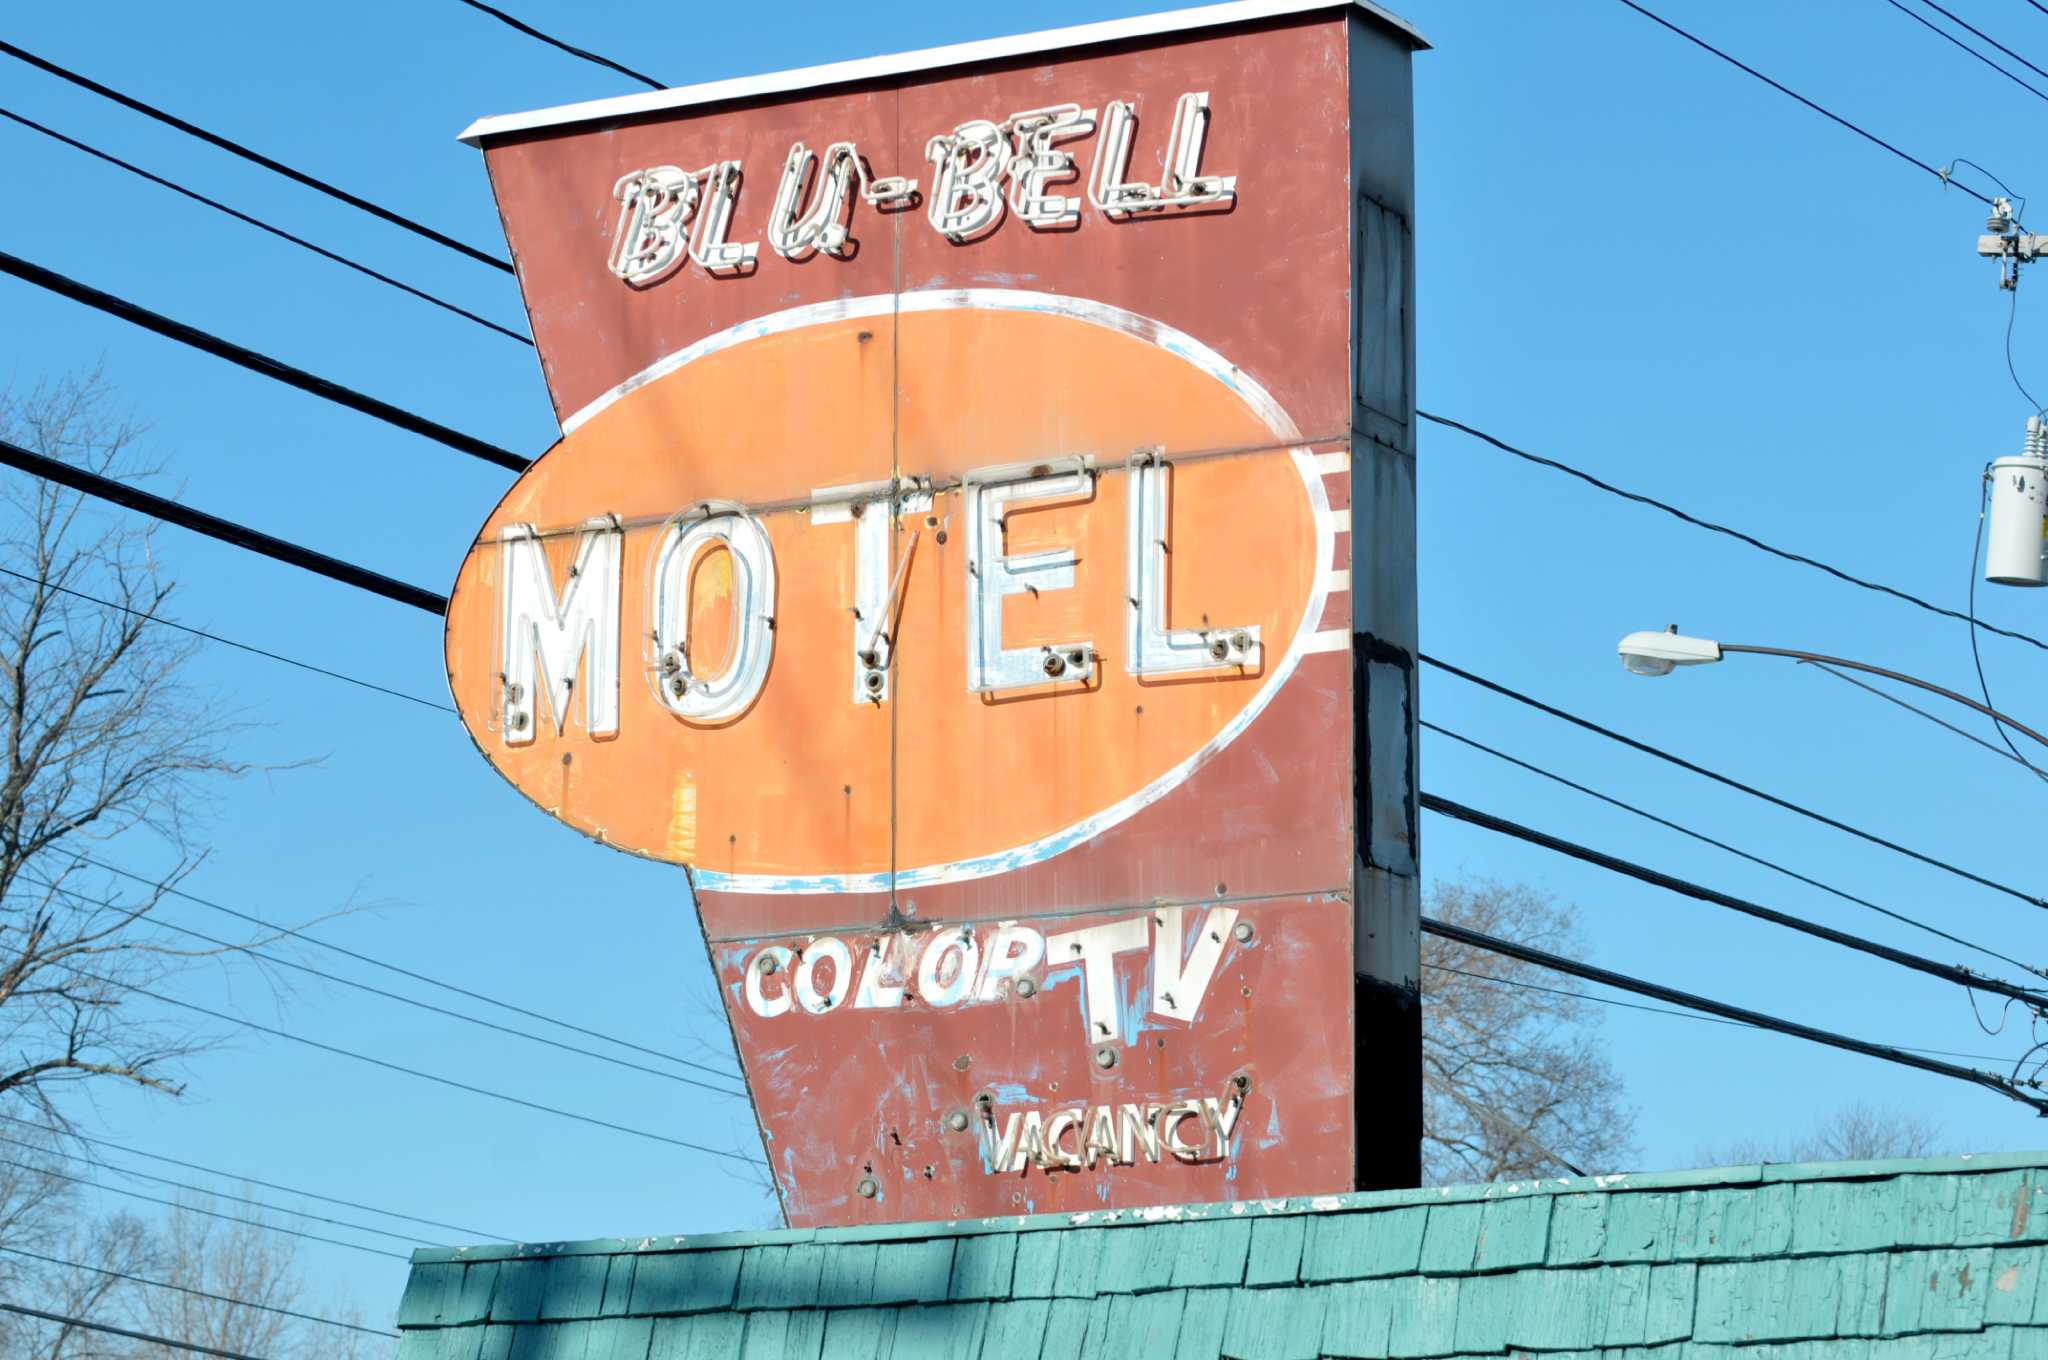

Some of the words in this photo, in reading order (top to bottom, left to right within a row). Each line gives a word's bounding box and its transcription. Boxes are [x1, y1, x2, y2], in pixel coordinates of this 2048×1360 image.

[607, 91, 1238, 288] BLU-BELL
[490, 446, 1264, 746] MOTEL
[1046, 906, 1239, 1044] TV
[980, 1096, 1240, 1172] VACANCY
